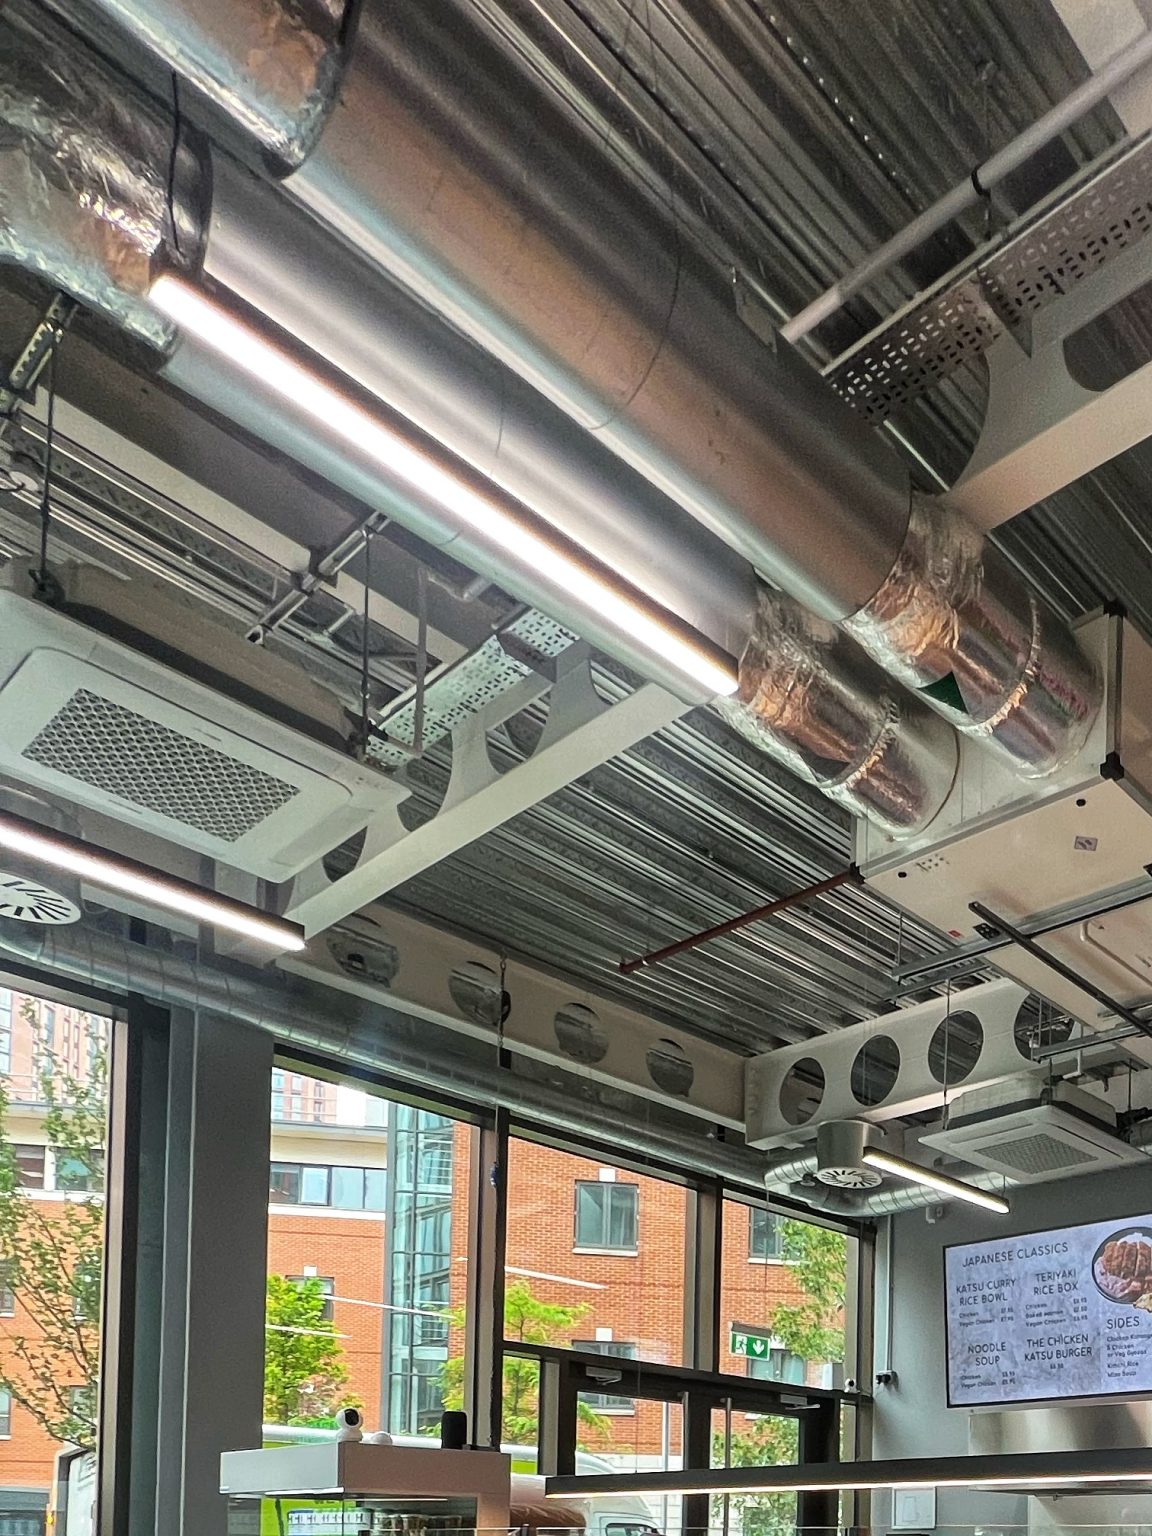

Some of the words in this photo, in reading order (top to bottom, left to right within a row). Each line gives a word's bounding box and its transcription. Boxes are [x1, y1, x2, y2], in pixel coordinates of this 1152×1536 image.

[962, 1250, 1014, 1268] JAPANESE
[1016, 1242, 1069, 1260] CLASSICS
[1035, 1268, 1077, 1283] TERIYAKI
[956, 1282, 984, 1295] KATSU
[987, 1278, 1016, 1291] CURRY
[1033, 1285, 1054, 1296] RICE
[1058, 1281, 1079, 1293] BOX
[960, 1295, 978, 1306] RICE
[981, 1292, 1008, 1304] BOWL
[1106, 1316, 1140, 1330] SIDES
[967, 1341, 1006, 1354] NOODLE
[1026, 1338, 1044, 1348] THE
[1047, 1333, 1089, 1346] CHICKEN
[975, 1355, 1000, 1367] SOUP
[1024, 1349, 1053, 1362] KATSU
[1056, 1346, 1092, 1359] BURGER
